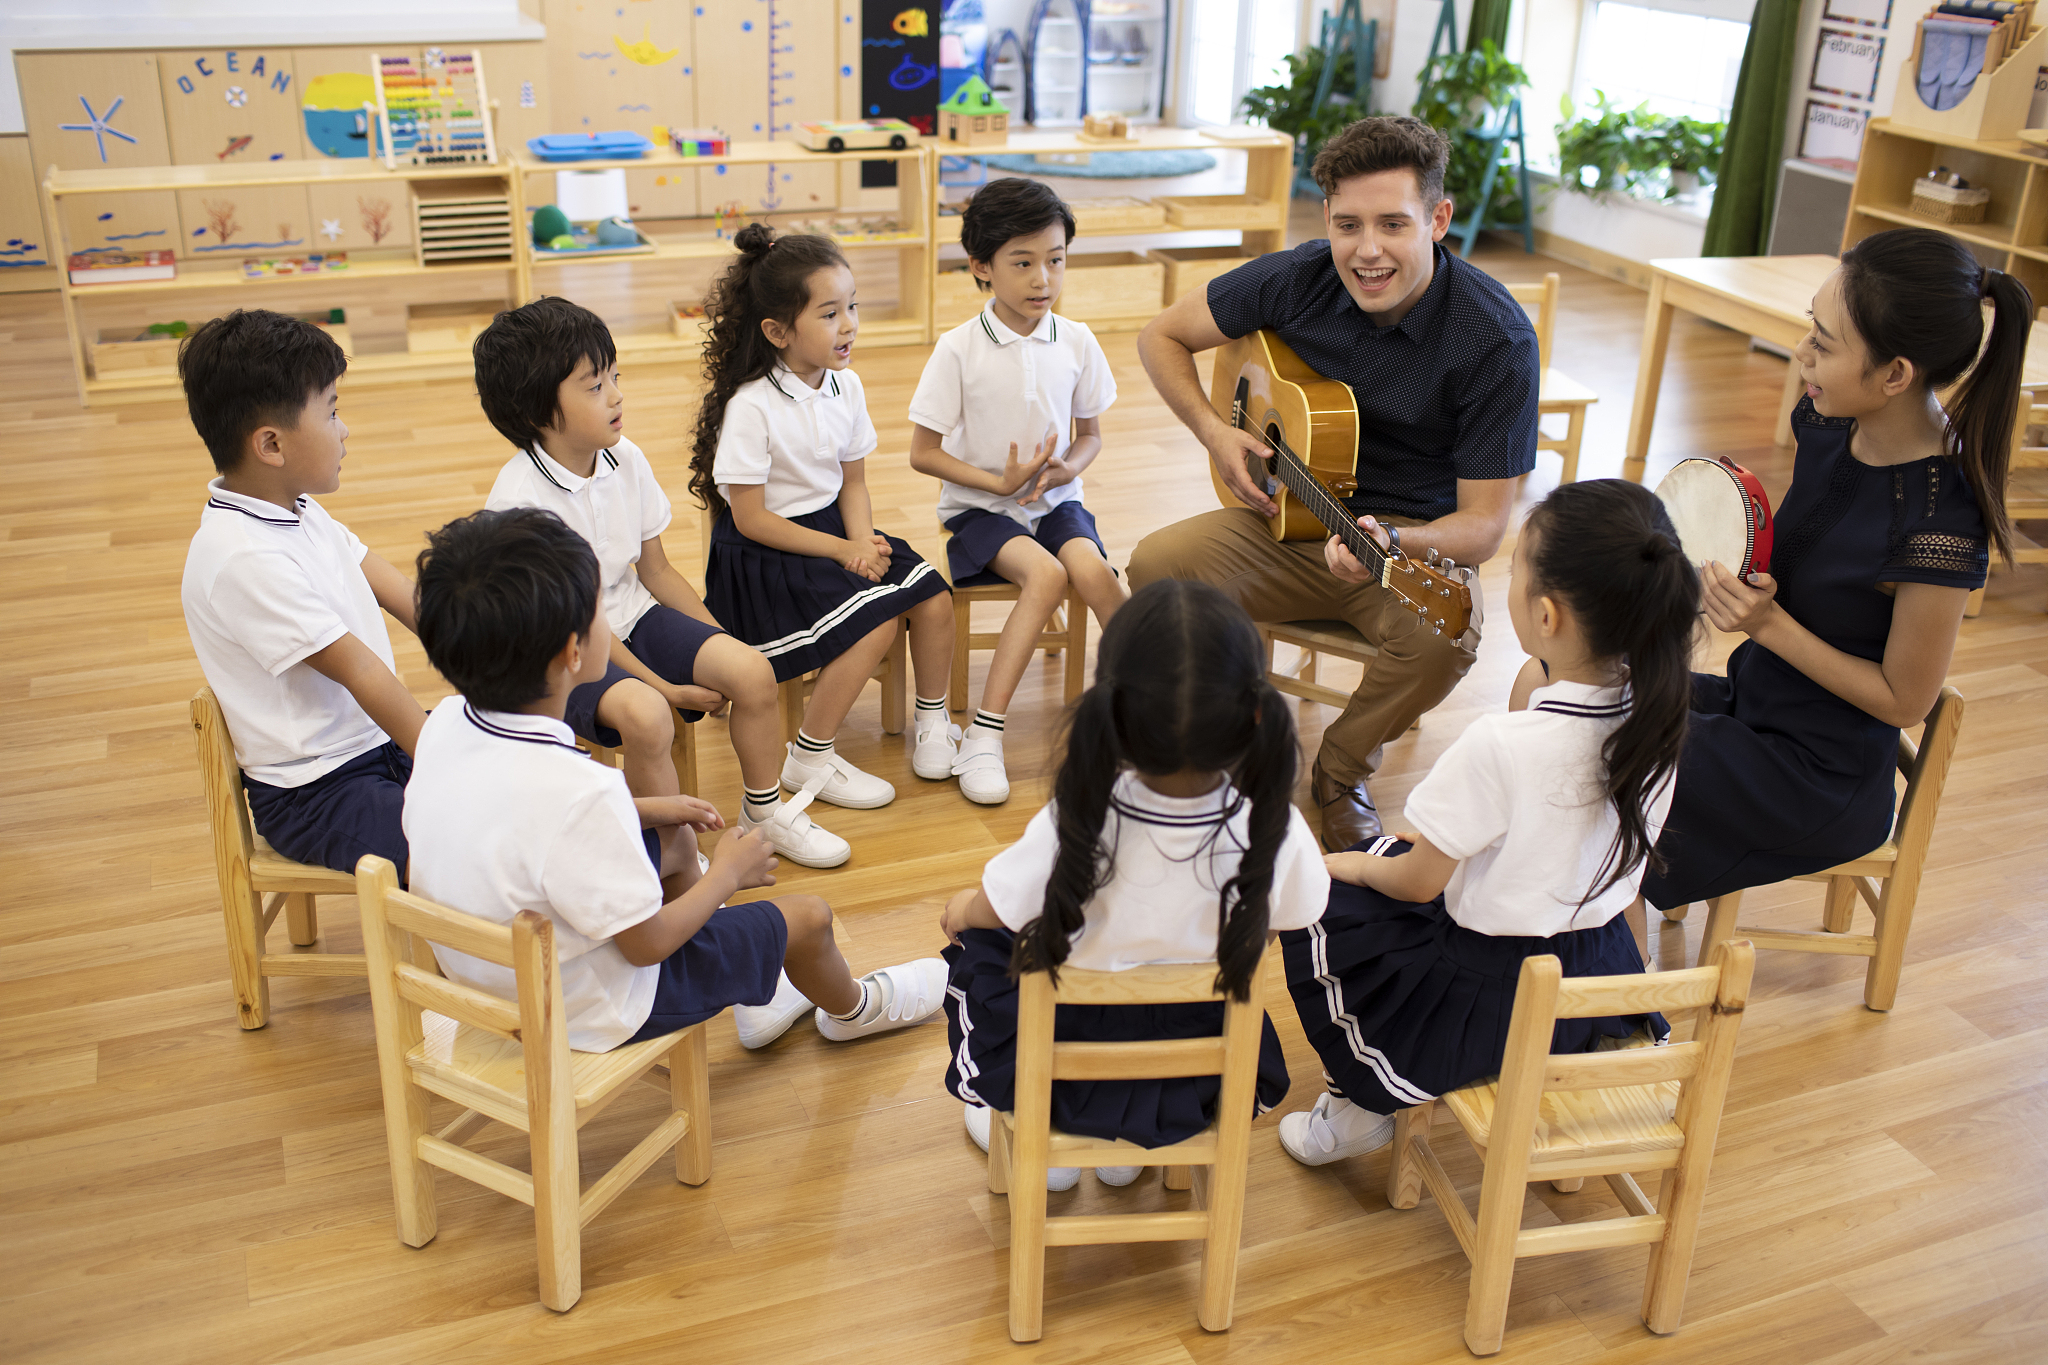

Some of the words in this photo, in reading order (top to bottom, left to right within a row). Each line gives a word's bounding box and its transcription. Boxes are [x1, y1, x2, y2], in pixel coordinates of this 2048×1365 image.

[1821, 33, 1880, 61] February
[177, 51, 291, 95] OCEAN
[1810, 107, 1863, 135] January
